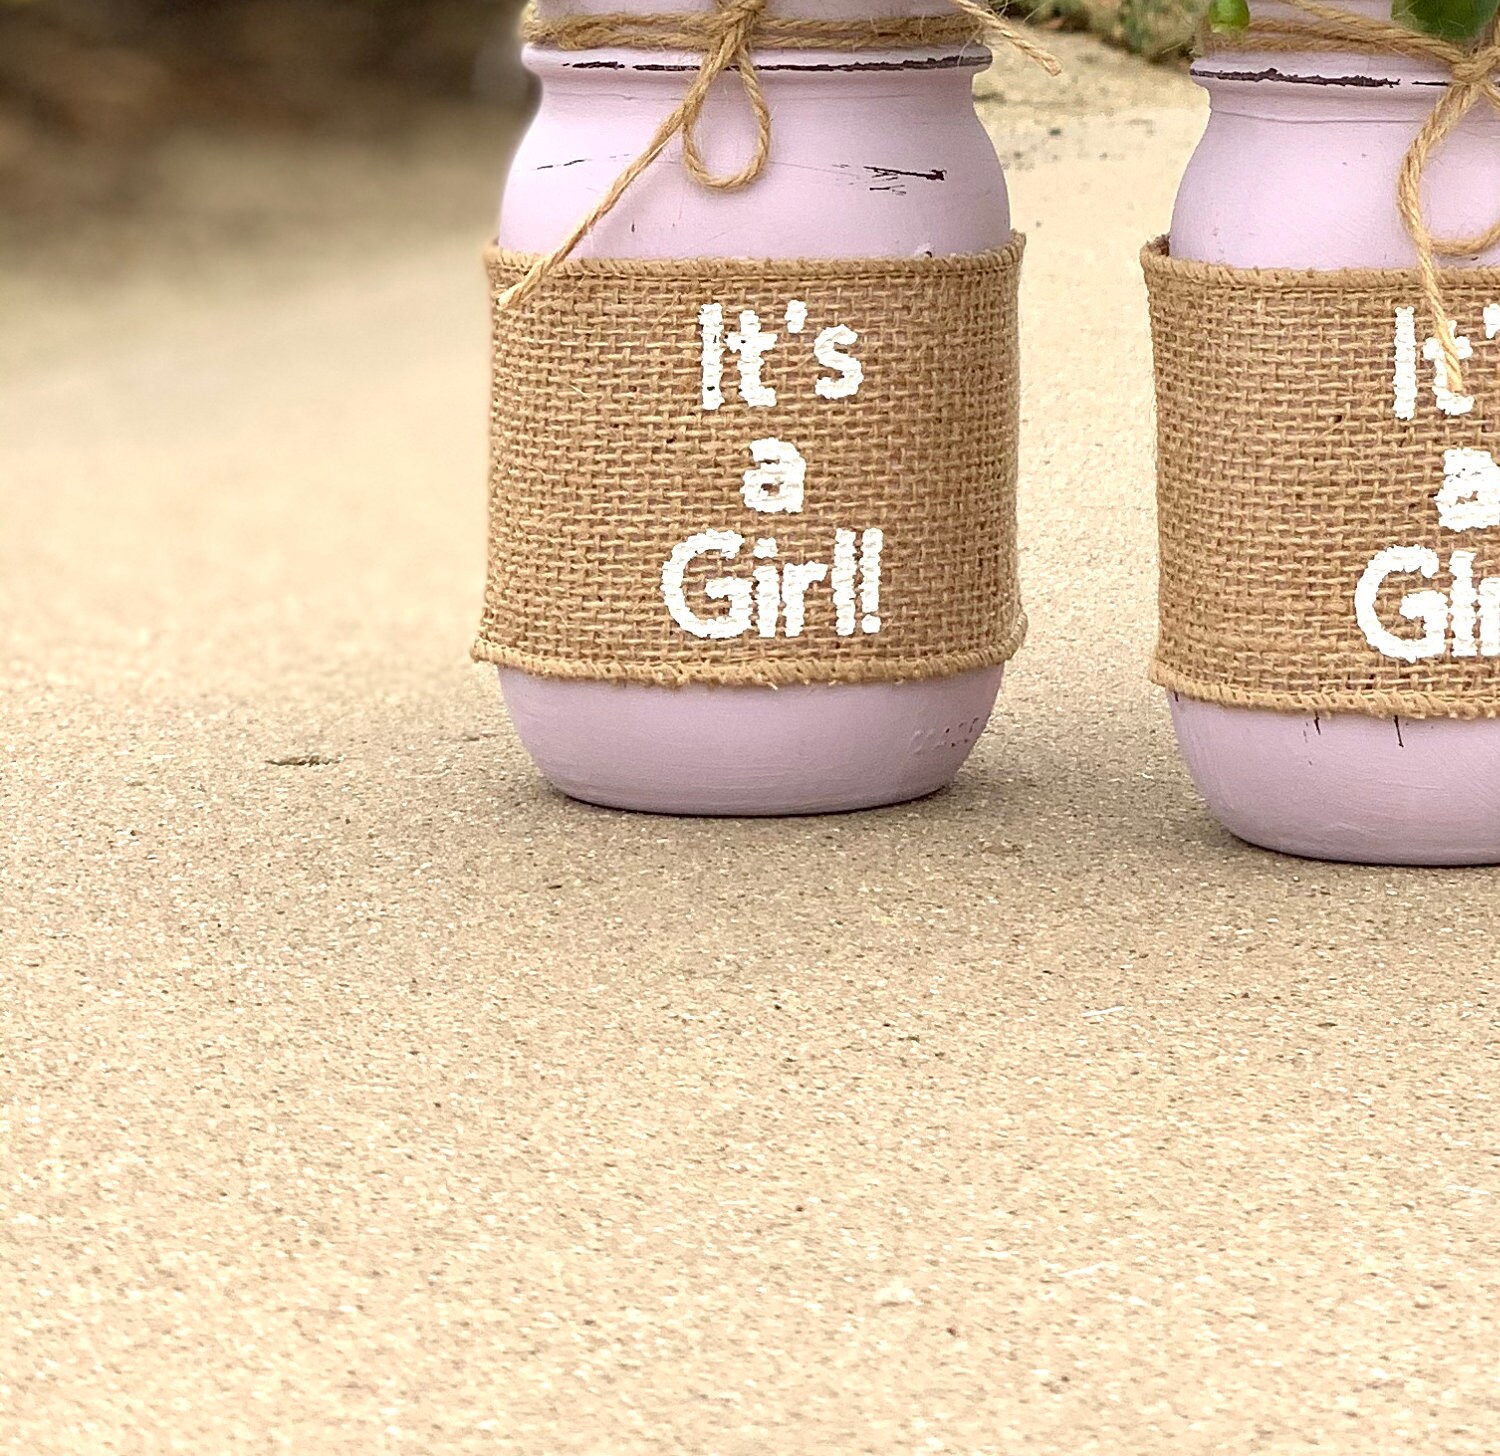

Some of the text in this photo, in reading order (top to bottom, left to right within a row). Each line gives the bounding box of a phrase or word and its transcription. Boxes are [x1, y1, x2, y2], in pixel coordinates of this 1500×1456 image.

[698, 299, 864, 411] It's
[740, 437, 807, 514] a
[660, 527, 884, 639] Girl!
